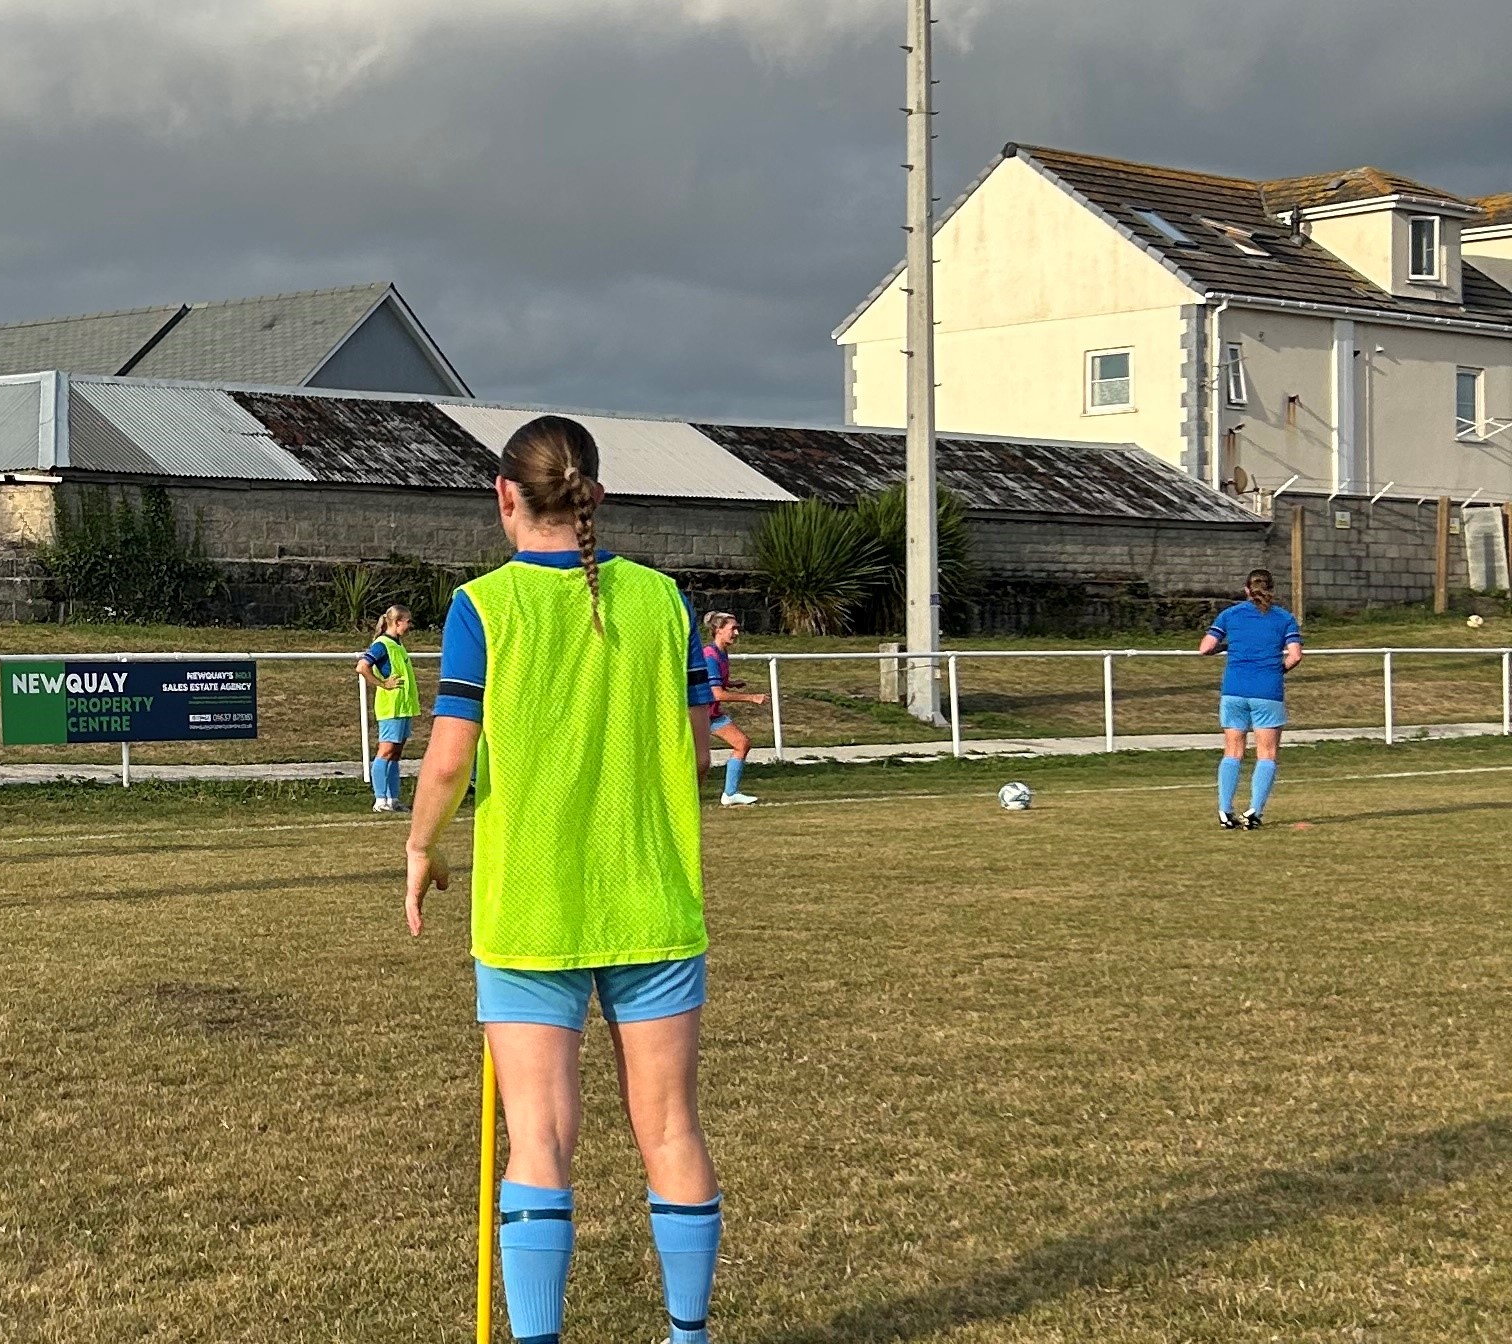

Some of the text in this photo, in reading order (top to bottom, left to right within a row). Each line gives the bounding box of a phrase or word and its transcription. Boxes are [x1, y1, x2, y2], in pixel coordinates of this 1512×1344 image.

[12, 672, 128, 694] NEWQUAY
[162, 682, 252, 692] SALES ESTATE AGENCY
[67, 696, 154, 714] PROPERTY
[67, 716, 131, 732] CENTRE
